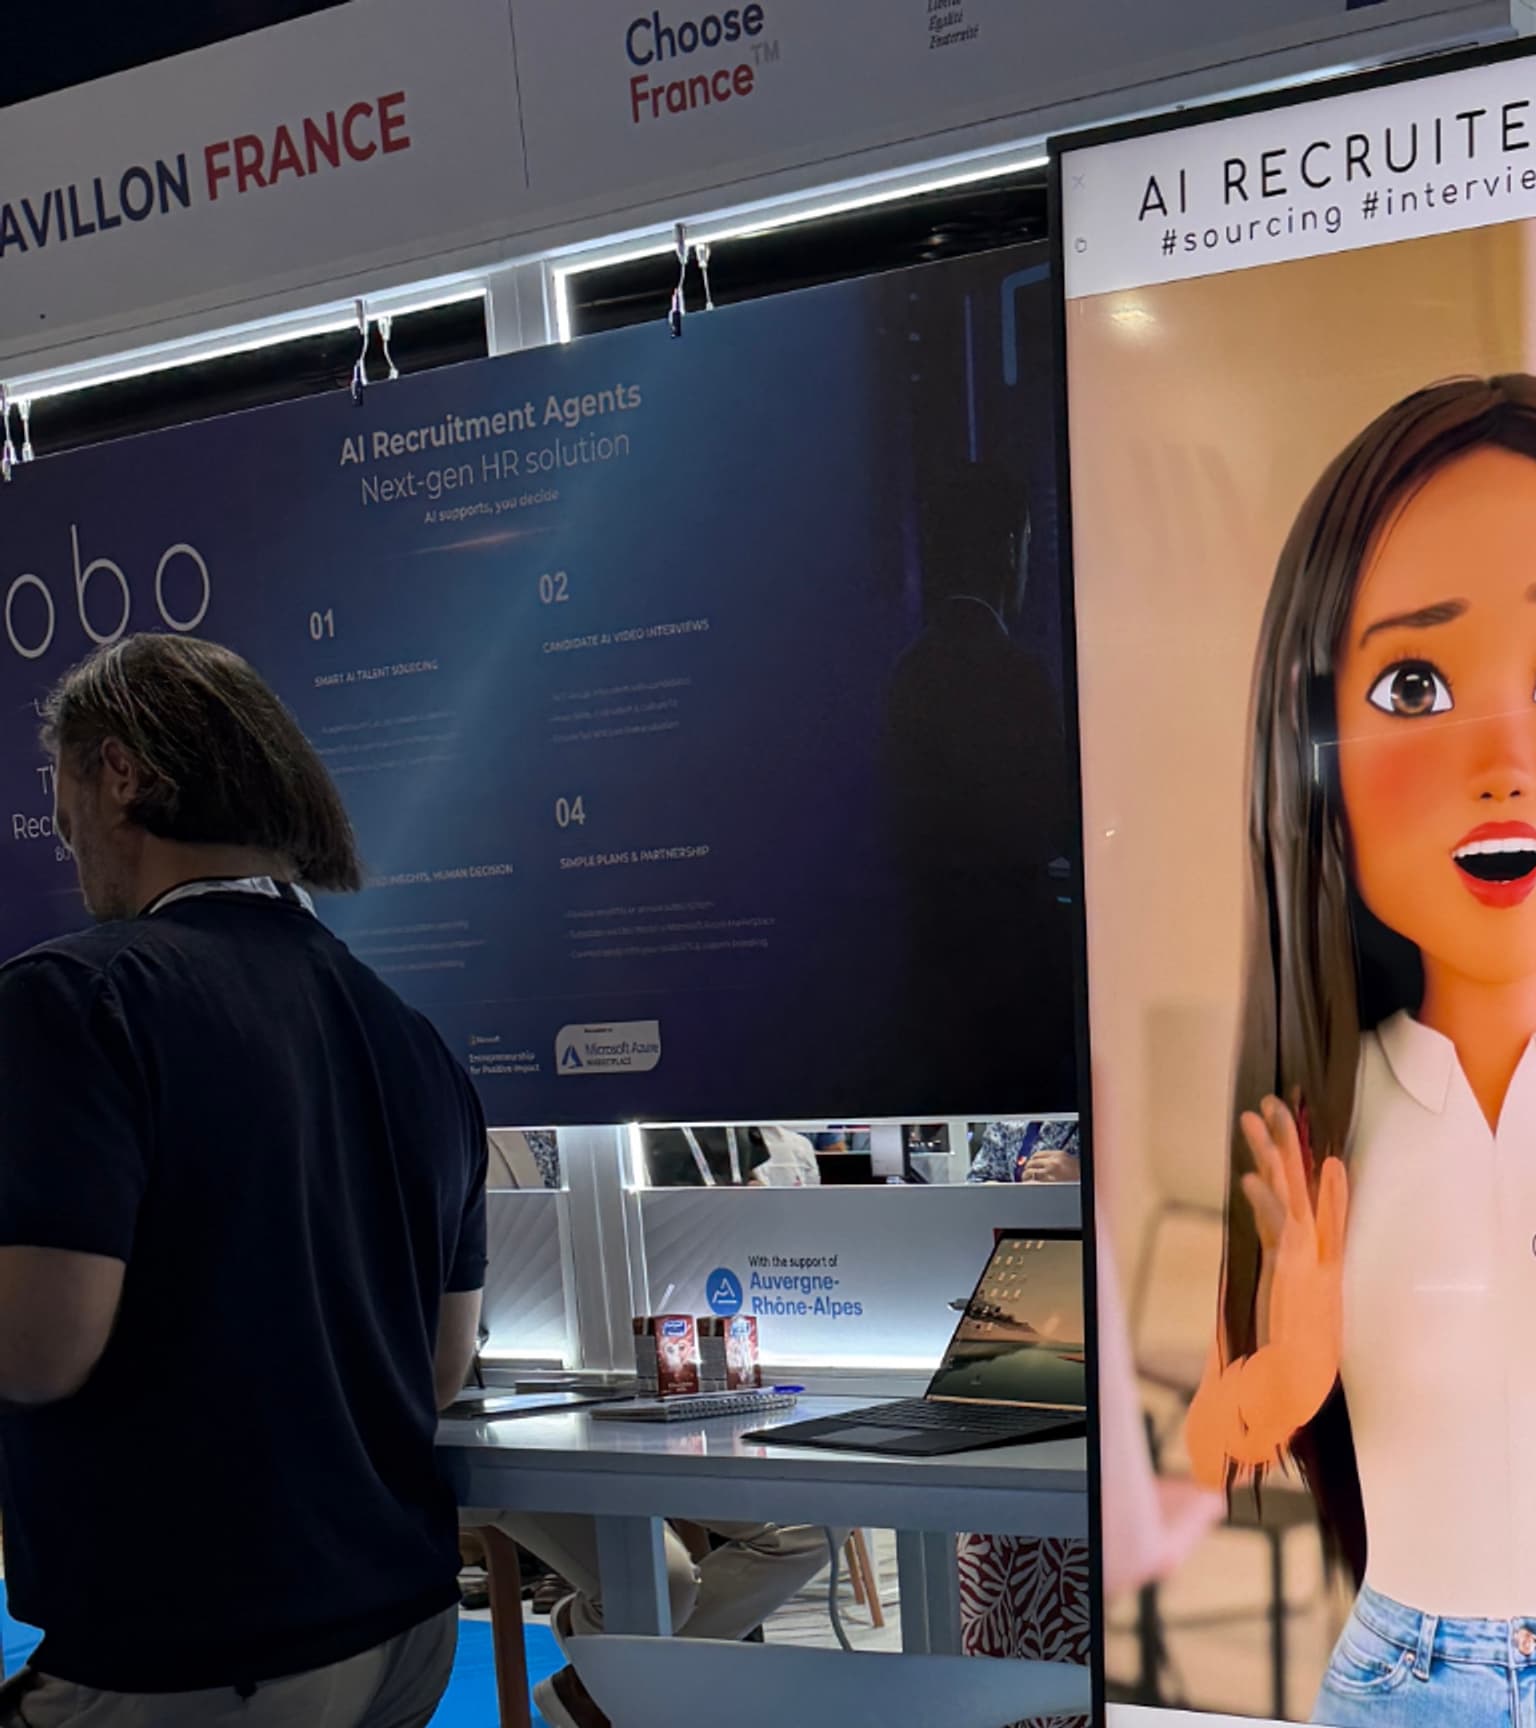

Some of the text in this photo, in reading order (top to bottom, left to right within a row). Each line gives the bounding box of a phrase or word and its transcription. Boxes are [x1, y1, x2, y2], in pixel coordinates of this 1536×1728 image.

[626, 3, 764, 66] Choose
[629, 63, 755, 124] France
[0, 91, 411, 258] AVILLON FRANCE
[1139, 168, 1186, 221] AI
[1161, 205, 1343, 256] #sourcing
[339, 383, 641, 467] AI Recruitment Agents
[361, 431, 630, 506] Next-gen HR solution
[424, 510, 437, 525] AI
[495, 496, 517, 514] you
[519, 488, 559, 507] decide
[5, 524, 211, 659] obo
[539, 571, 570, 604] 02
[309, 608, 336, 641] 01
[555, 795, 587, 828] 04
[640, 844, 711, 862] PARTNERSHIP
[748, 1254, 839, 1270] With the support of
[750, 1271, 840, 1295] Auvergne-
[751, 1296, 864, 1320] Rhône-Alpes
